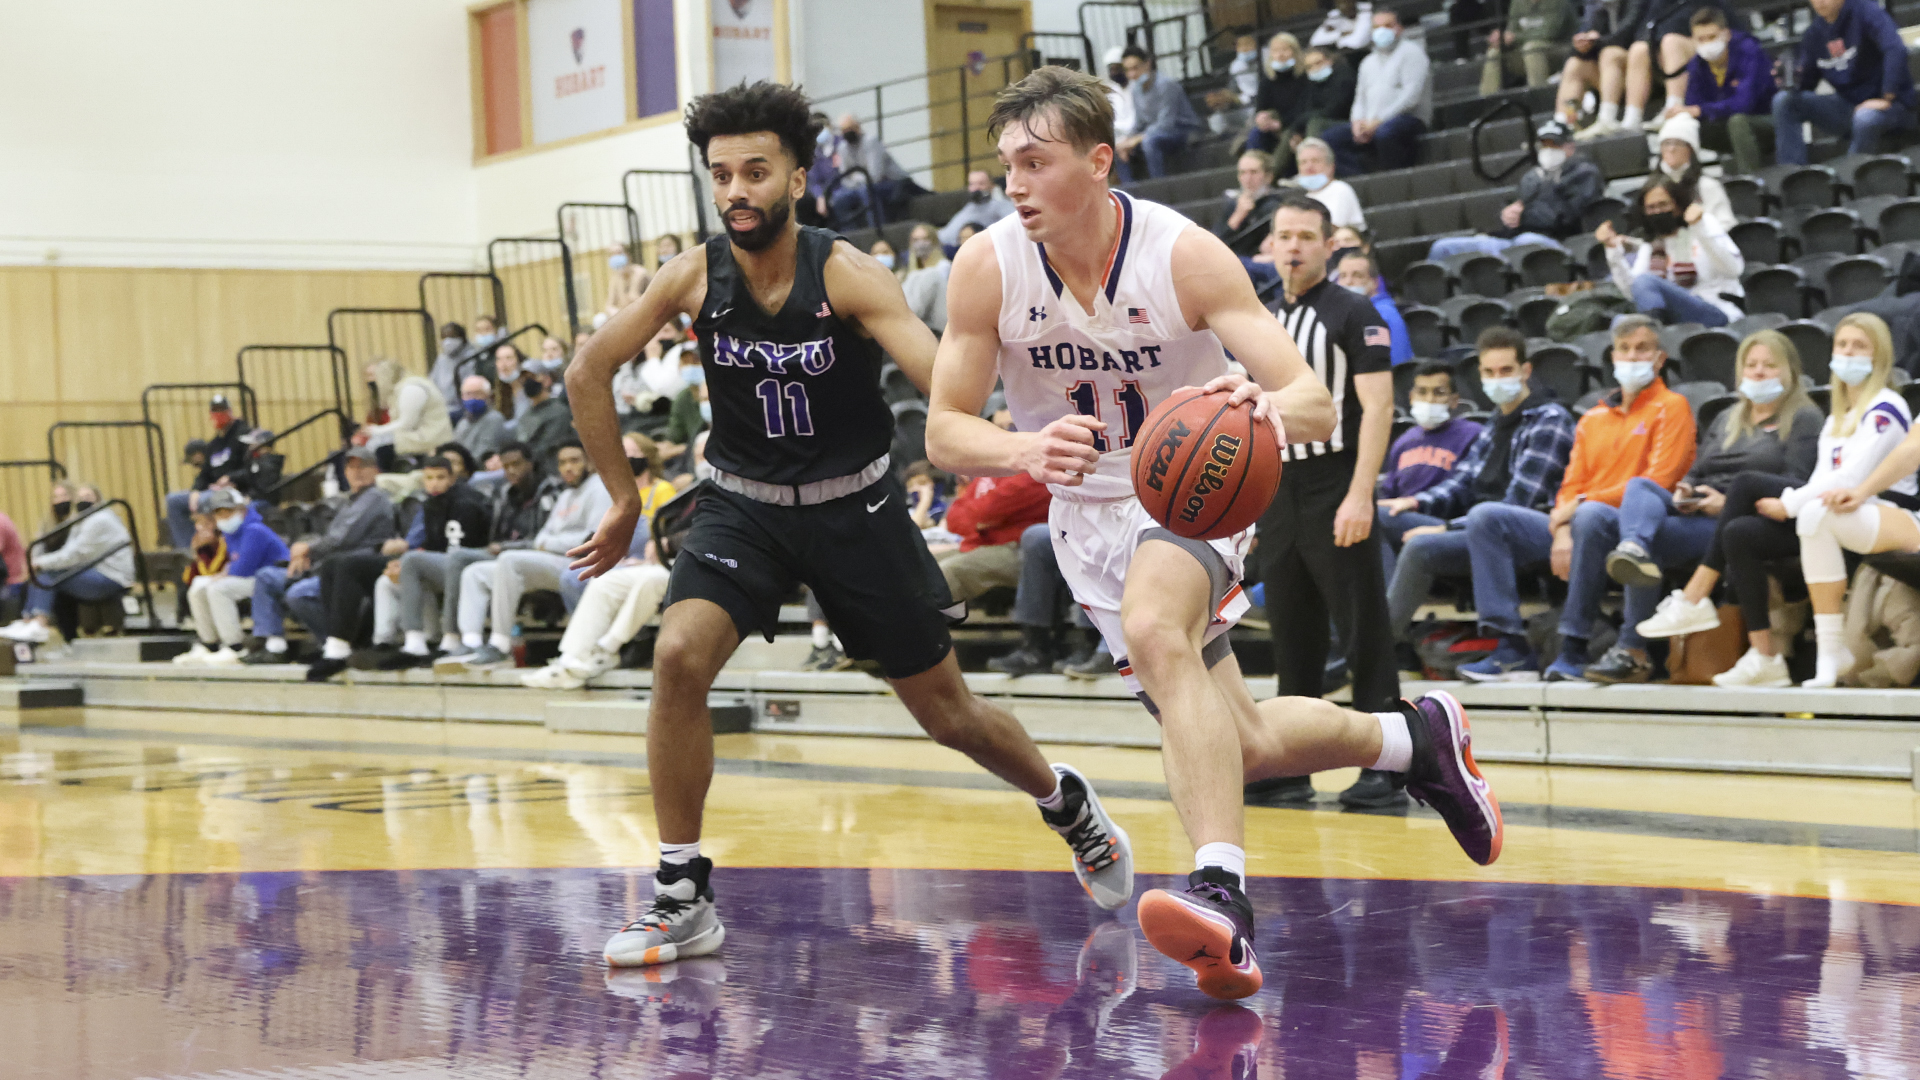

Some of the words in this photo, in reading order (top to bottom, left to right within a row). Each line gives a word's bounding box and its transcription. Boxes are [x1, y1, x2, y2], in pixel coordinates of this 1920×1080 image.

[714, 331, 836, 376] NYU
[1028, 342, 1162, 374] HOBART
[756, 378, 815, 438] 11
[1066, 380, 1150, 455] 11
[1146, 420, 1191, 492] NCAA
[1177, 433, 1243, 523] Wilson
